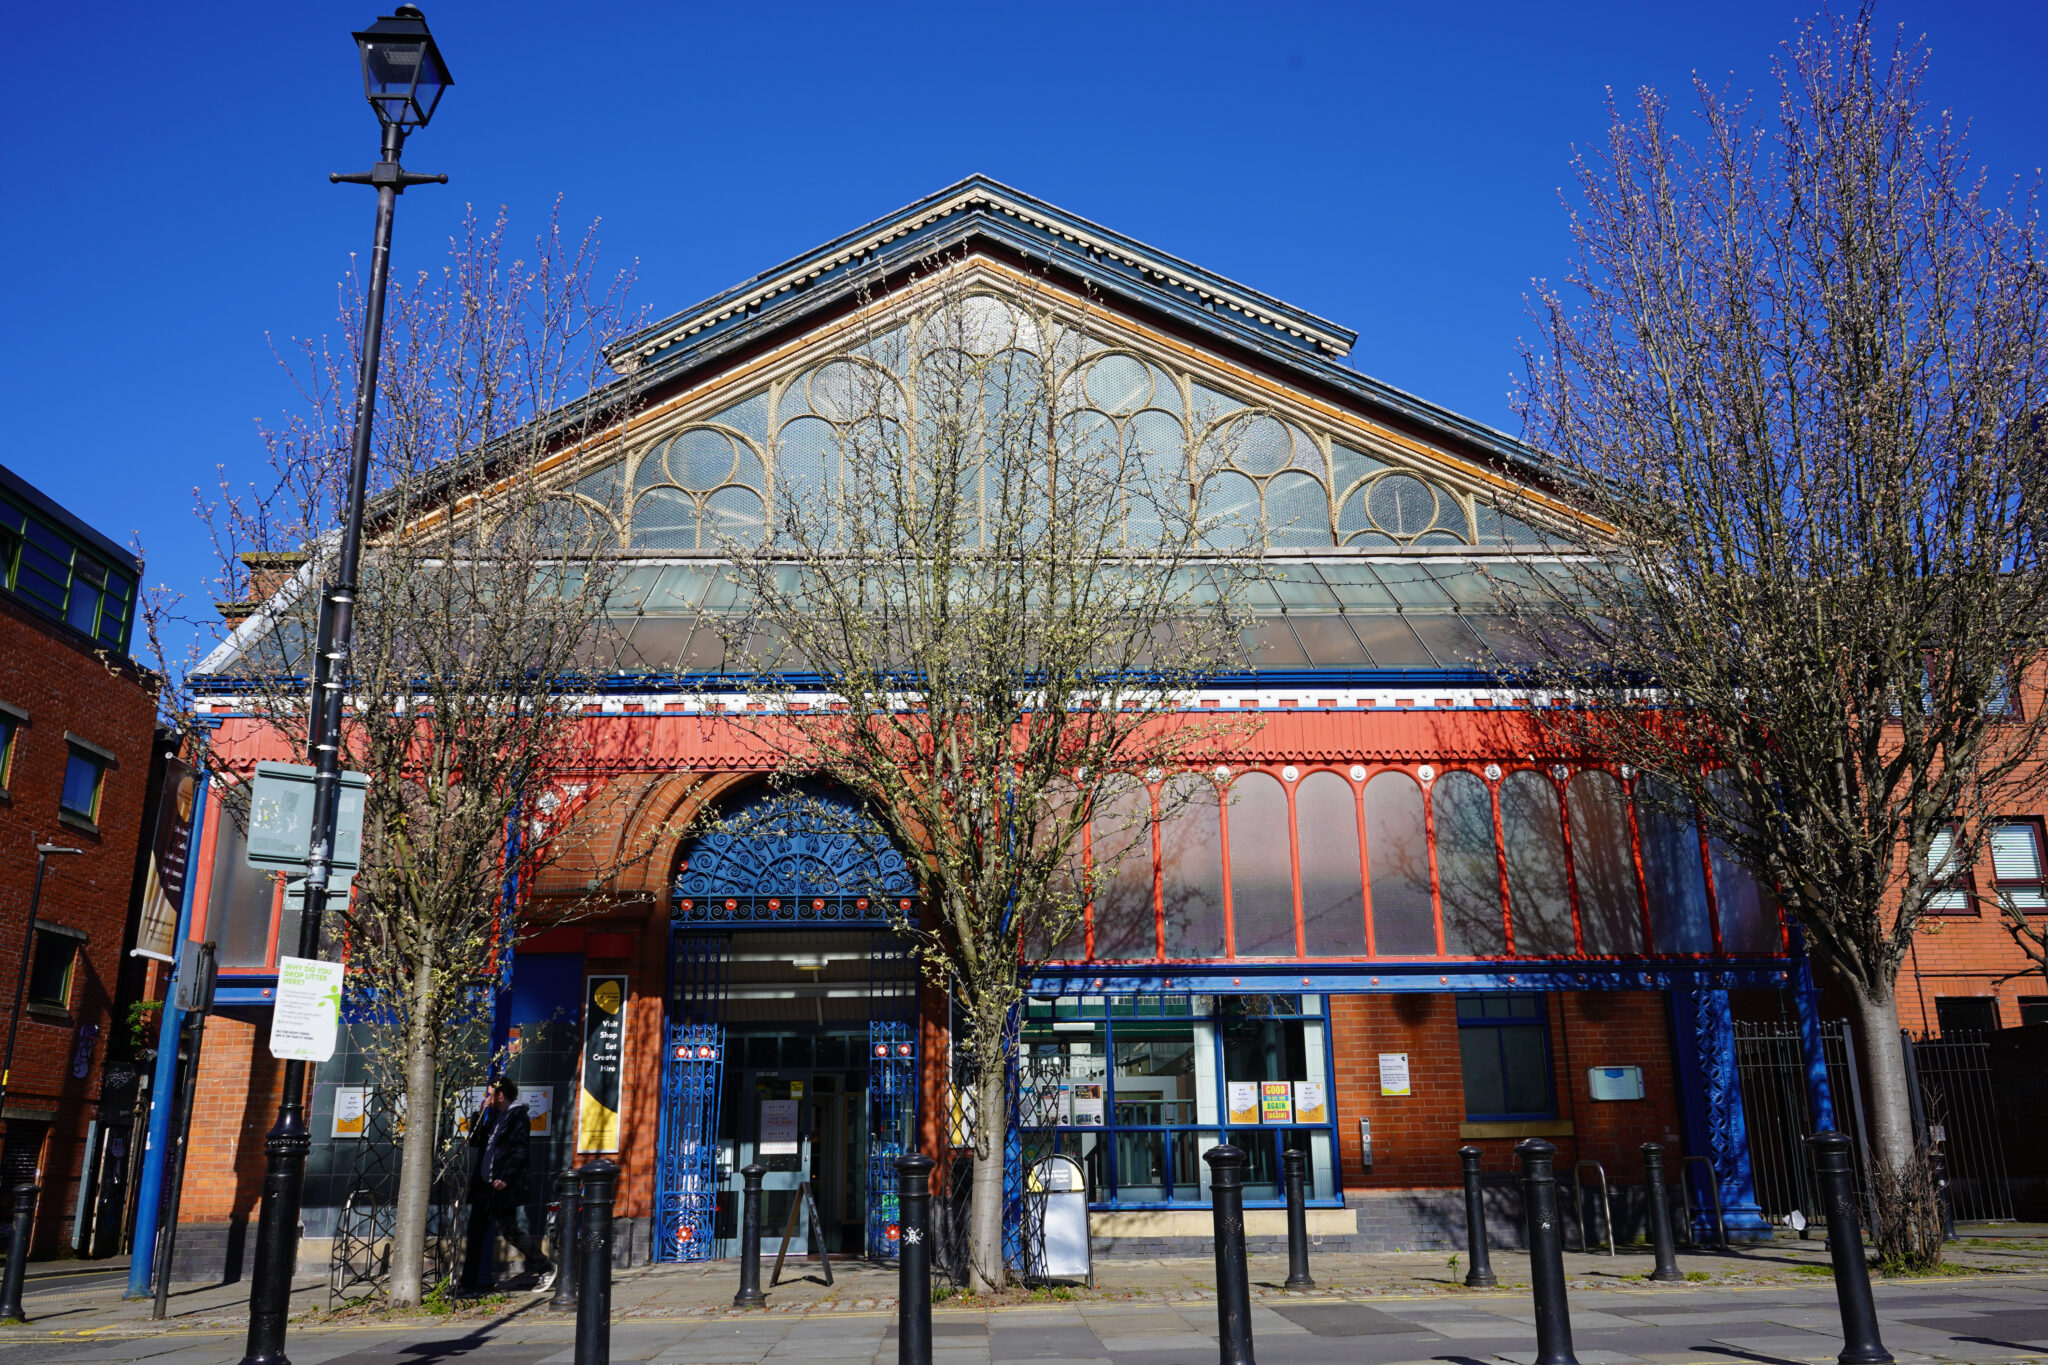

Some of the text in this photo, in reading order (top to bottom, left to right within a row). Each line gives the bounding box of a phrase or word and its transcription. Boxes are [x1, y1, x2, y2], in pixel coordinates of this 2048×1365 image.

[304, 965, 316, 973] DO
[317, 967, 332, 975] YOU
[284, 970, 327, 981] DROP LITTER
[283, 977, 305, 985] HERE?
[602, 1020, 618, 1028] Visit
[600, 1031, 618, 1039] Shop
[605, 1042, 617, 1050] Eat
[592, 1053, 617, 1061] Create
[1266, 1085, 1285, 1094] GOOD
